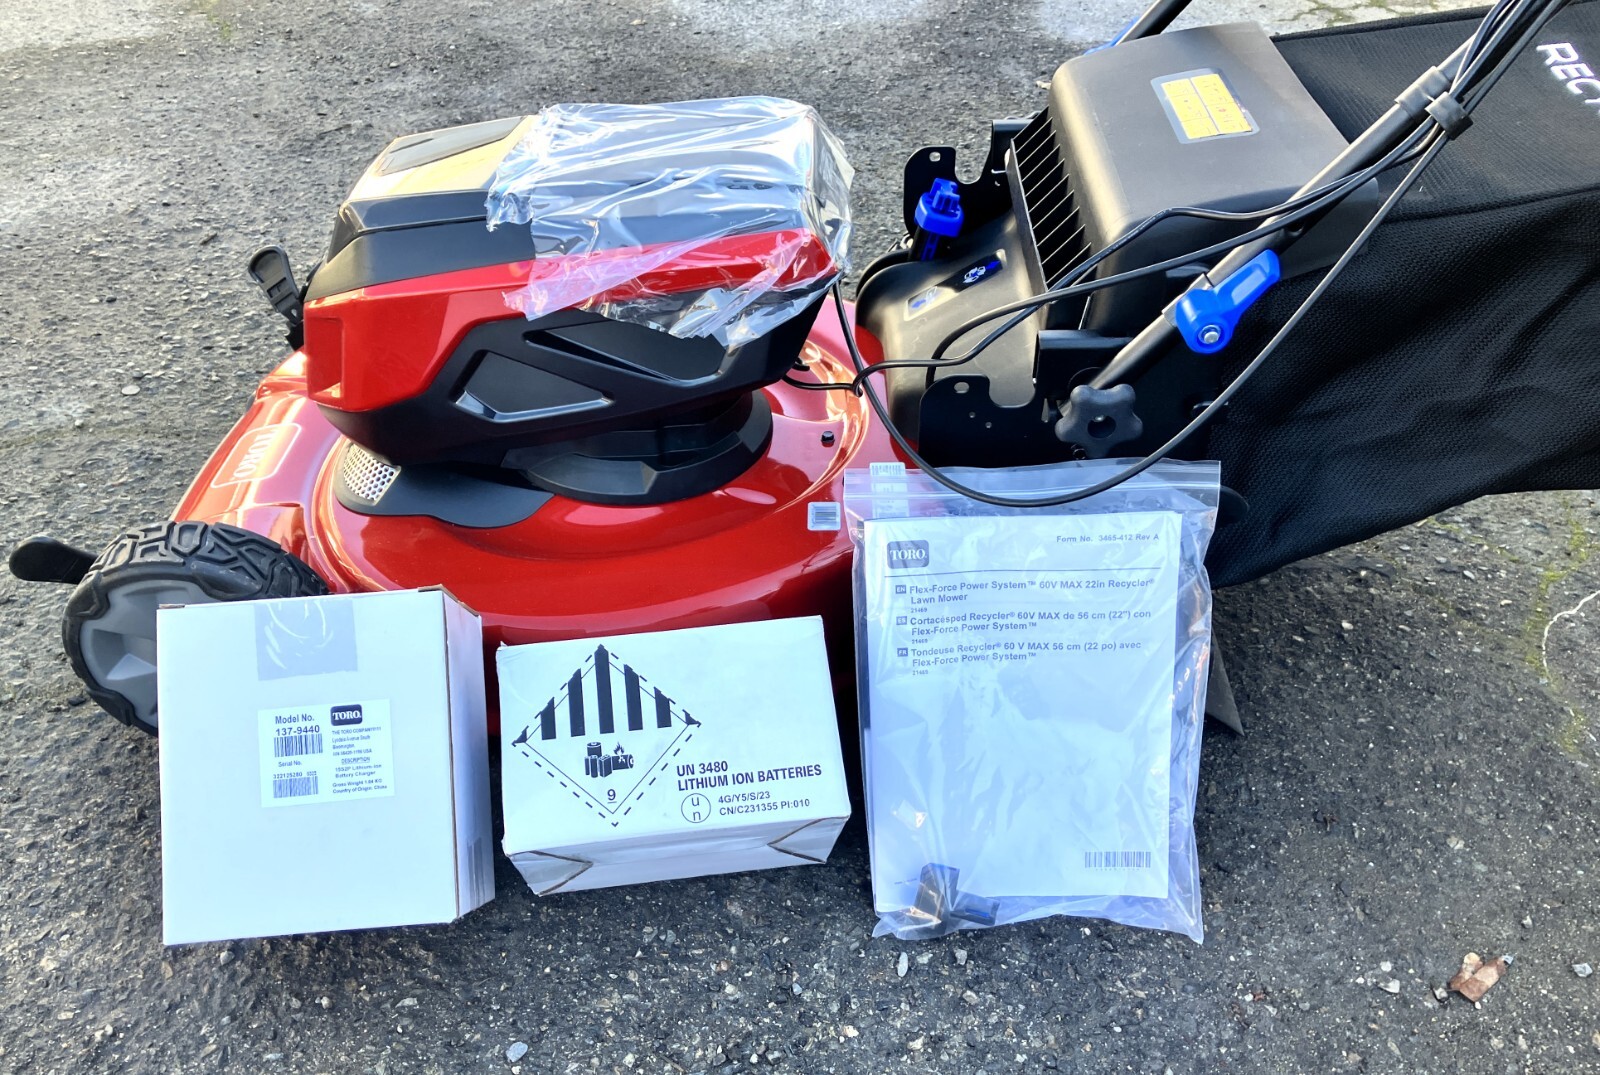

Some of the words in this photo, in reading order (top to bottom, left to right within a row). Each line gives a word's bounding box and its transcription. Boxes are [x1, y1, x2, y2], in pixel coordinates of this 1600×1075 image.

[889, 548, 926, 561] TORO
[910, 584, 958, 594] Flex-Force
[960, 582, 989, 590] Power
[1039, 580, 1058, 589] 60V
[1060, 580, 1083, 589] MAX
[1085, 580, 1105, 589] 22in
[911, 596, 936, 605] Lawn
[938, 594, 968, 603] Mower
[1017, 612, 1036, 620] 60V
[1038, 612, 1060, 620] MAX
[1063, 612, 1075, 620] de
[1077, 612, 1089, 620] 56
[912, 626, 958, 636] Flex-Force
[911, 646, 954, 656] Tondeuse
[1004, 642, 1015, 650] 60
[1018, 642, 1024, 650] V
[1028, 642, 1050, 650] MAX
[1052, 642, 1064, 650] 56
[1084, 642, 1098, 651] (22
[1101, 642, 1117, 651] po)
[912, 657, 959, 667] Flex-Force
[962, 654, 990, 662] Power
[275, 714, 300, 724] Model
[301, 713, 315, 722] No.
[332, 710, 361, 720] TORO
[275, 724, 320, 736] 137-9440
[676, 763, 695, 777] UN
[698, 760, 729, 775] 3480
[678, 774, 729, 792] LITHIUM
[732, 772, 754, 786] ION
[758, 764, 822, 783] BATTERIES
[607, 788, 616, 801] 9
[718, 791, 771, 804] 4G/Y5/S/23
[719, 802, 778, 816] CN/C231355
